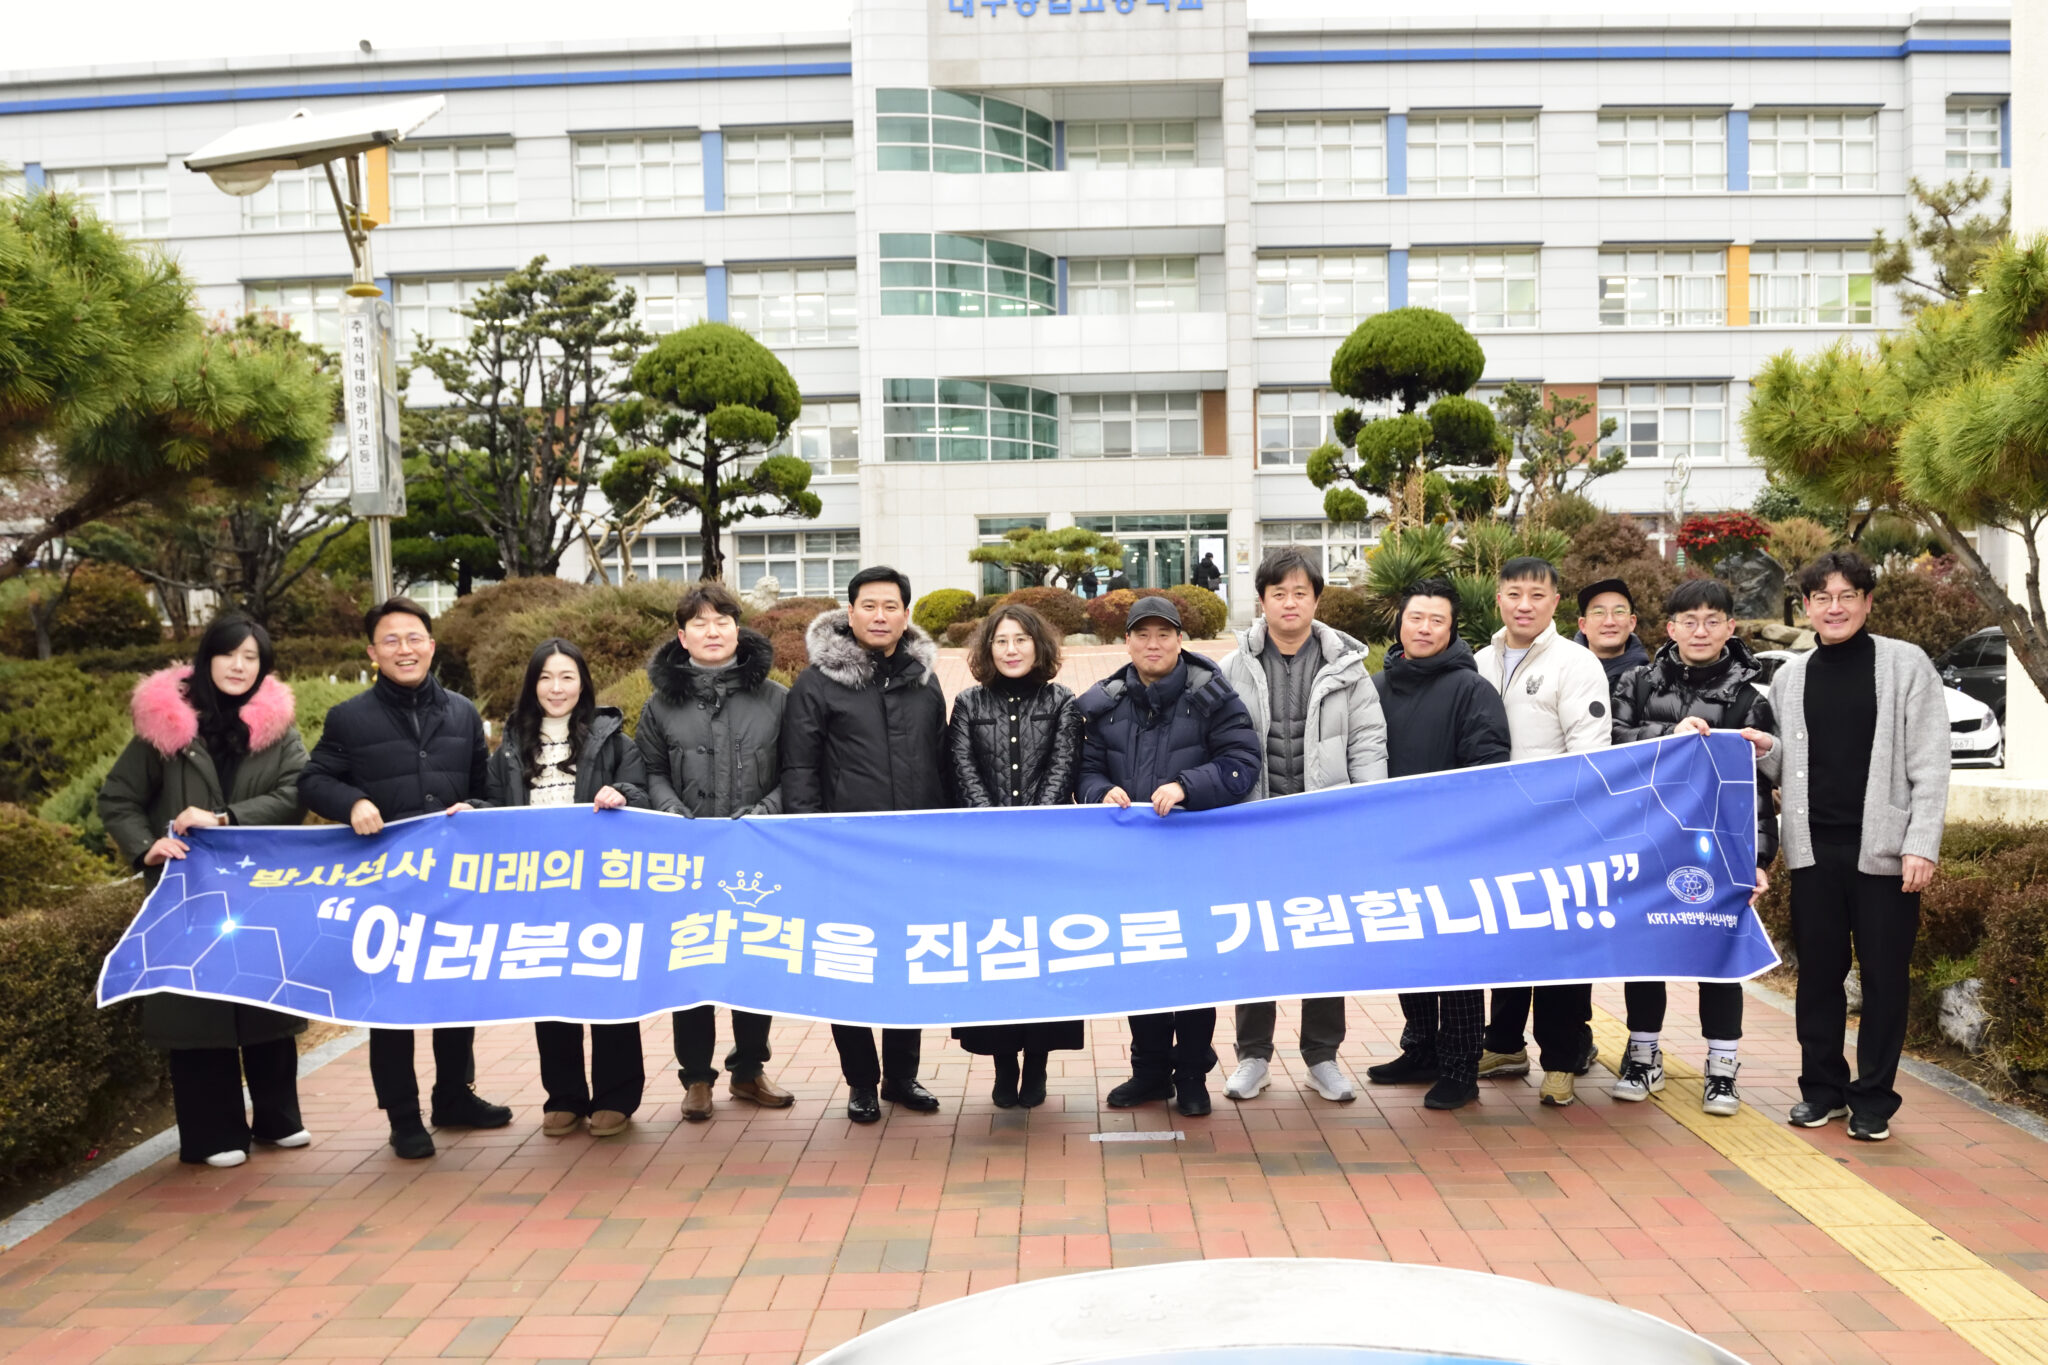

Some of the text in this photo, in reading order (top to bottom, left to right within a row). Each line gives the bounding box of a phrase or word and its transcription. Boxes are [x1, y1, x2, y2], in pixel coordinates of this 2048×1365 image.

[248, 847, 706, 894] 방사선사 미래의 희망!
[667, 909, 879, 985] 합격을
[905, 909, 1189, 985] 진심으로
